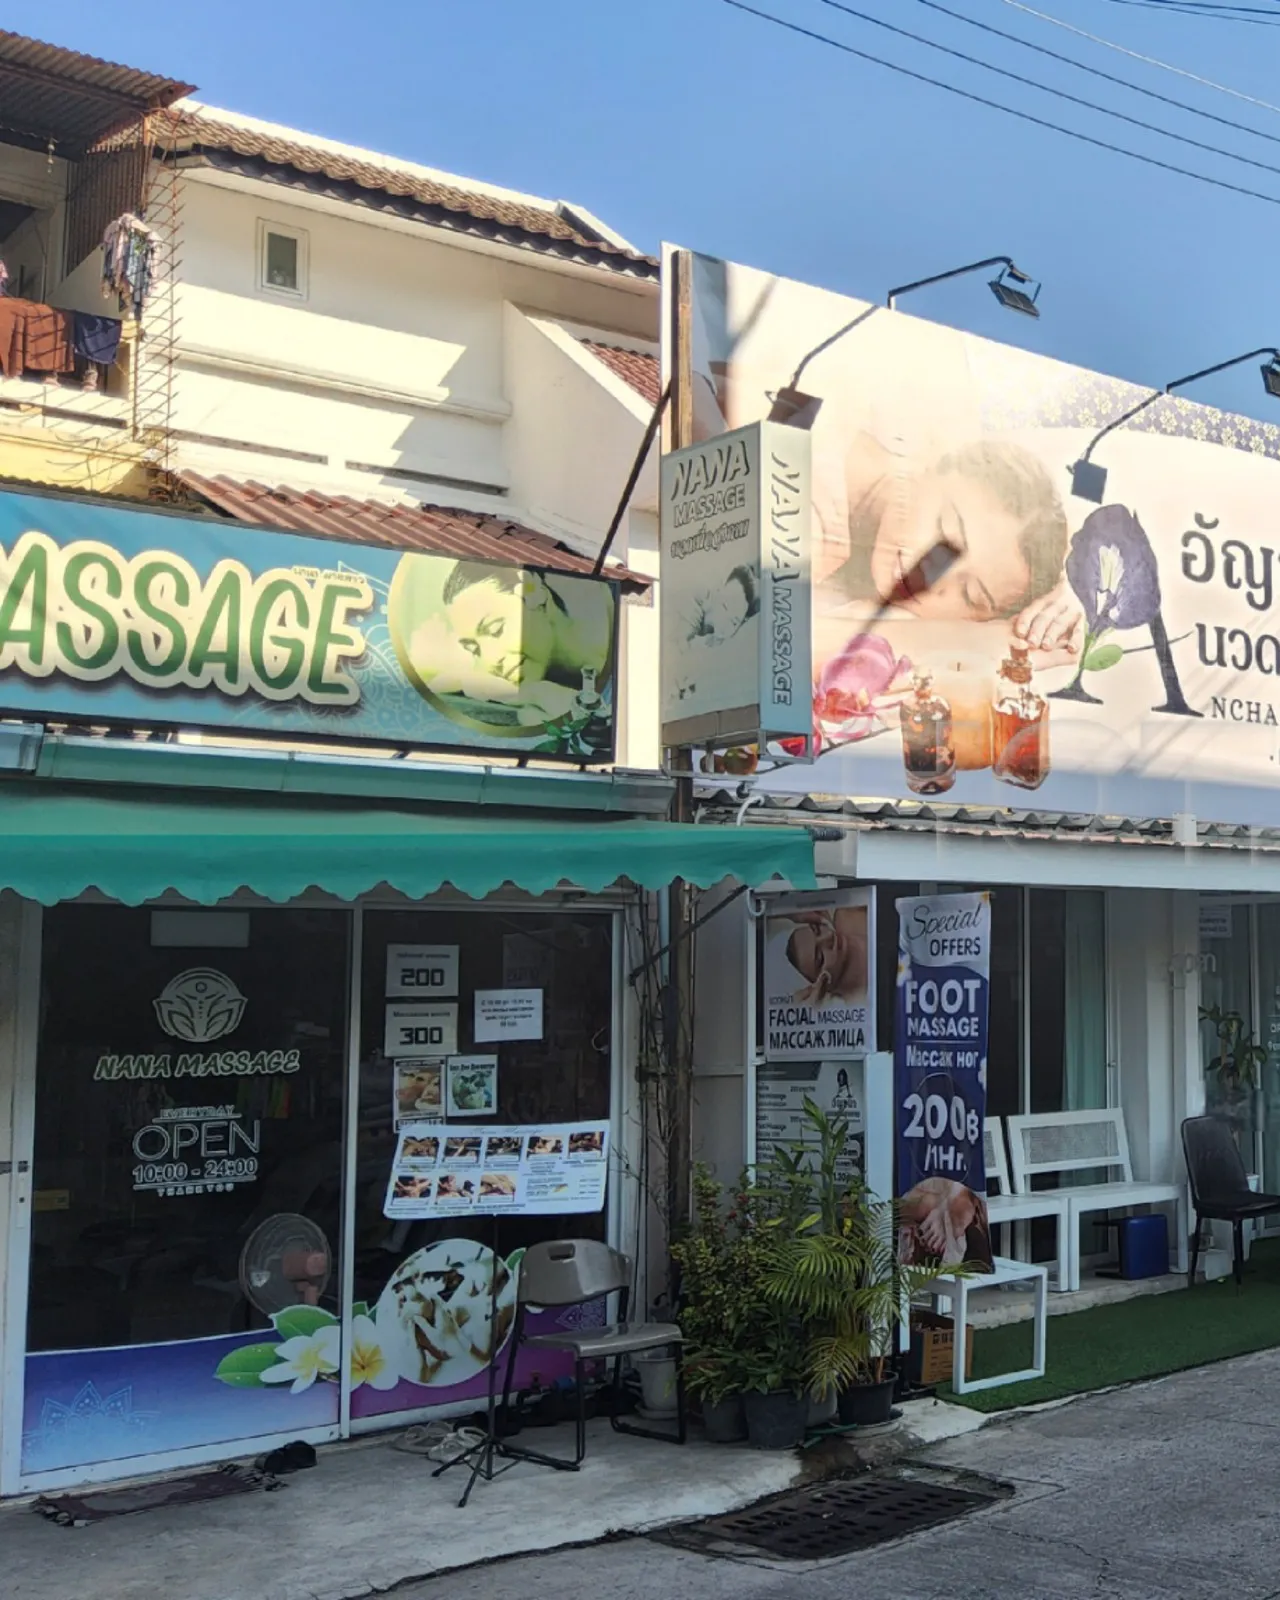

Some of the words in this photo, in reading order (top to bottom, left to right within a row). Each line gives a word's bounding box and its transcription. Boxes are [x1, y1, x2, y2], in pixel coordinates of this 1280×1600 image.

[671, 440, 750, 501] NANA
[674, 483, 746, 528] MASSAGE
[771, 452, 801, 584] NANA
[772, 587, 793, 706] MASSAGE
[906, 902, 982, 940] Special
[929, 936, 982, 957] OFFERS
[400, 967, 445, 987] 200
[905, 978, 982, 1015] FOOT
[768, 1007, 816, 1028] FACIAL
[818, 1007, 866, 1025] MASSAGE
[906, 1016, 980, 1038] MASSAGE
[399, 1026, 443, 1046] 300
[769, 1030, 826, 1051] МАССАЖ
[827, 1027, 865, 1050] ЛИЦА
[94, 1054, 171, 1081] NANA
[174, 1049, 301, 1078] MASSAGE
[956, 1051, 979, 1068] ног
[132, 1119, 260, 1161] OPEN
[132, 1163, 188, 1183] 10:00
[203, 1157, 258, 1178] 24:00
